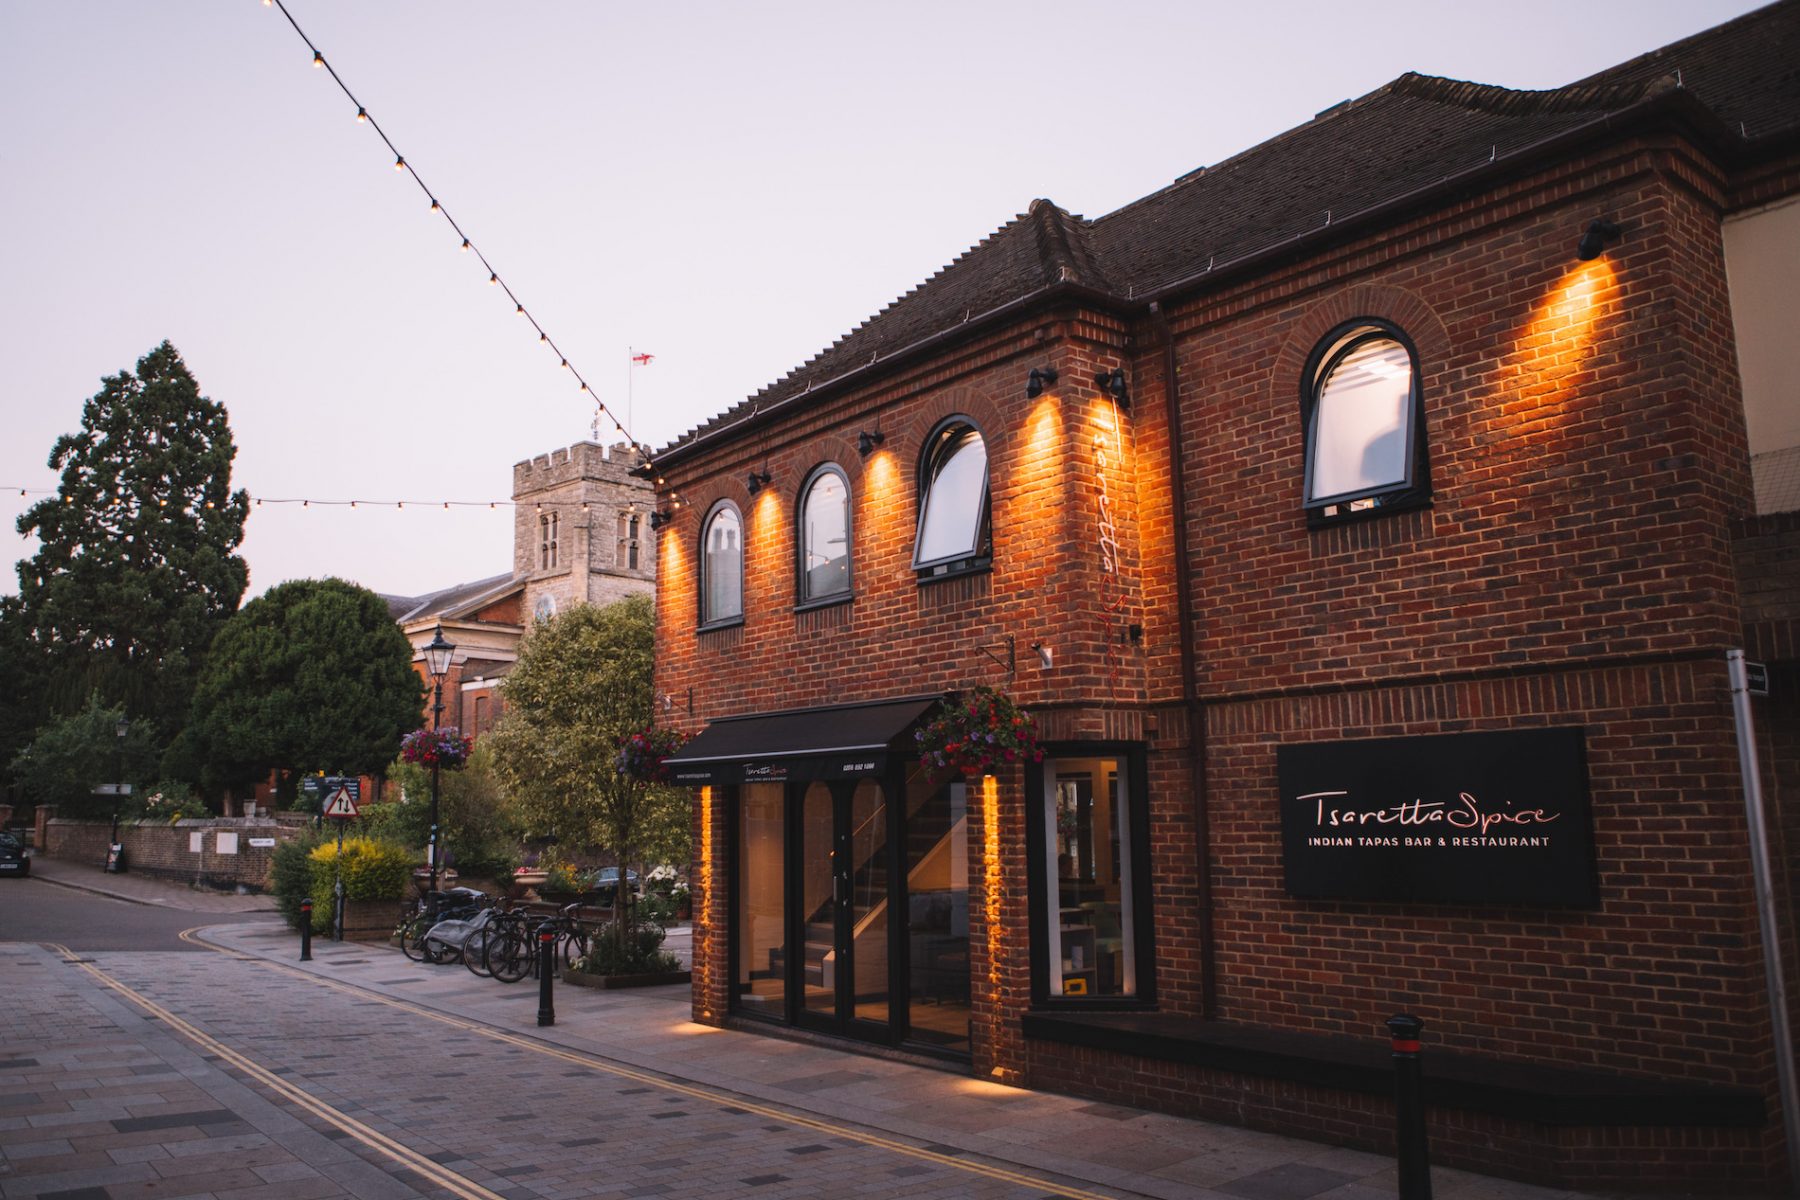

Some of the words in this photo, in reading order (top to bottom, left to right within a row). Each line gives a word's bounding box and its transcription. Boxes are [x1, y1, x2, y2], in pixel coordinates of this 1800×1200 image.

[1092, 397, 1122, 576] Tsaretta
[1296, 791, 1445, 826] Tsaretta
[1447, 792, 1560, 835] Spice
[1308, 837, 1353, 846] INDIAN
[1358, 837, 1399, 846] TAPAS
[1405, 837, 1431, 846] BAR
[1438, 837, 1446, 846] &
[1452, 837, 1549, 847] RESTAURANT
